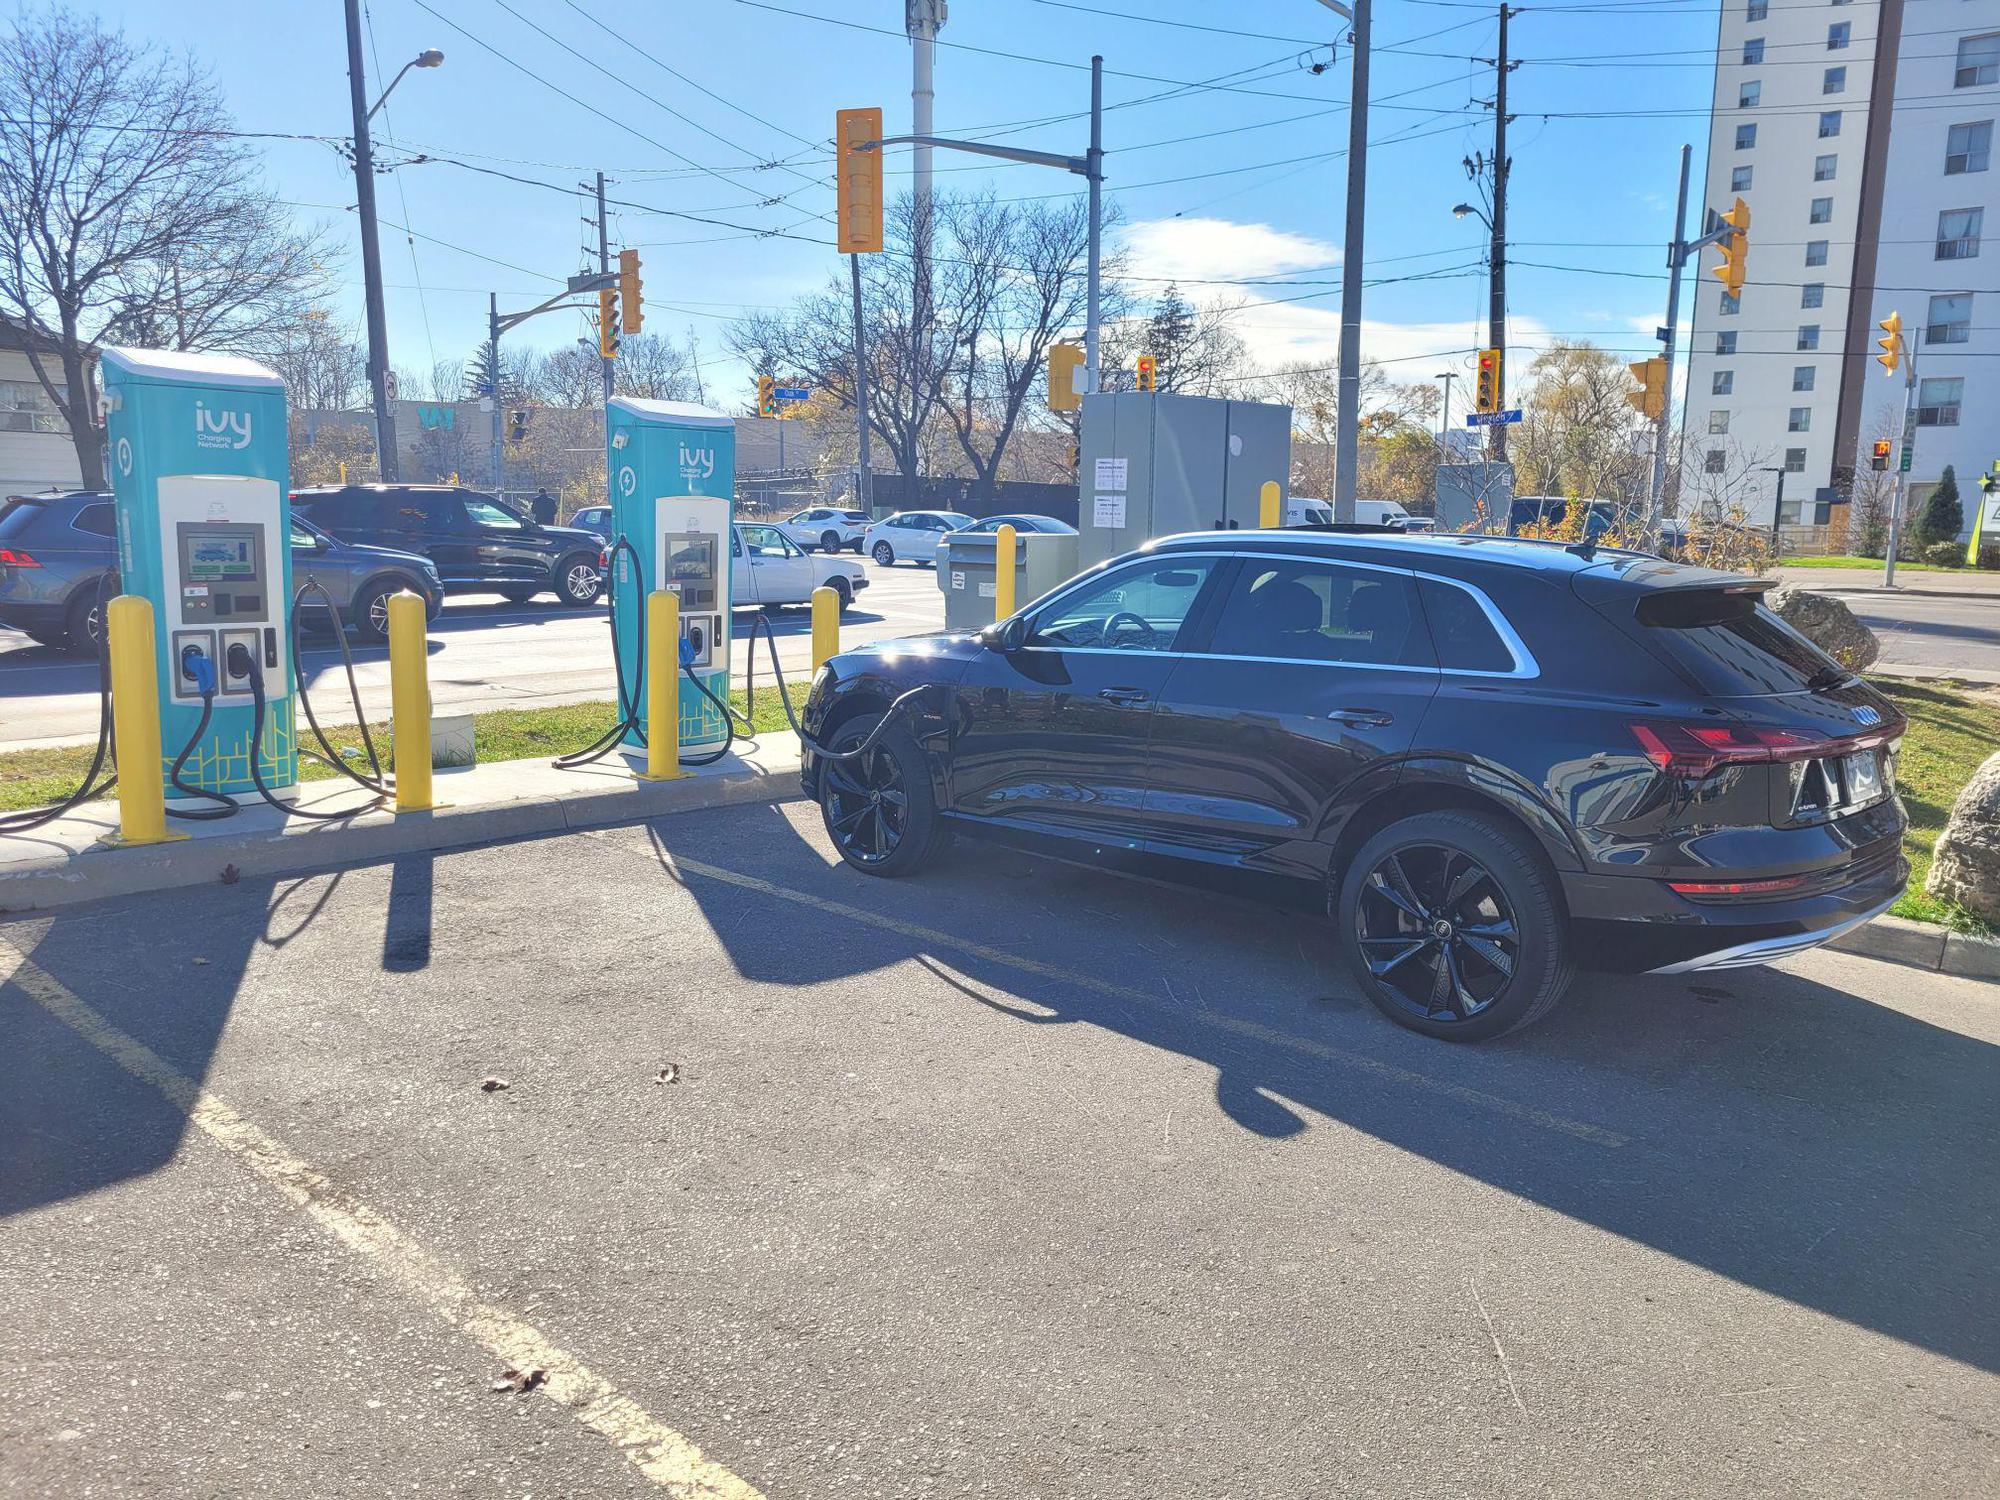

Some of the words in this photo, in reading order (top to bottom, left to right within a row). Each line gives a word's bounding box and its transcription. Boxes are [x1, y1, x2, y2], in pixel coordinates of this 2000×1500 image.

[195, 400, 252, 450] ivy
[198, 433, 232, 444] Charging
[198, 440, 230, 449] Network
[679, 441, 715, 479] ivy
[1797, 803, 1818, 811] e-tron
